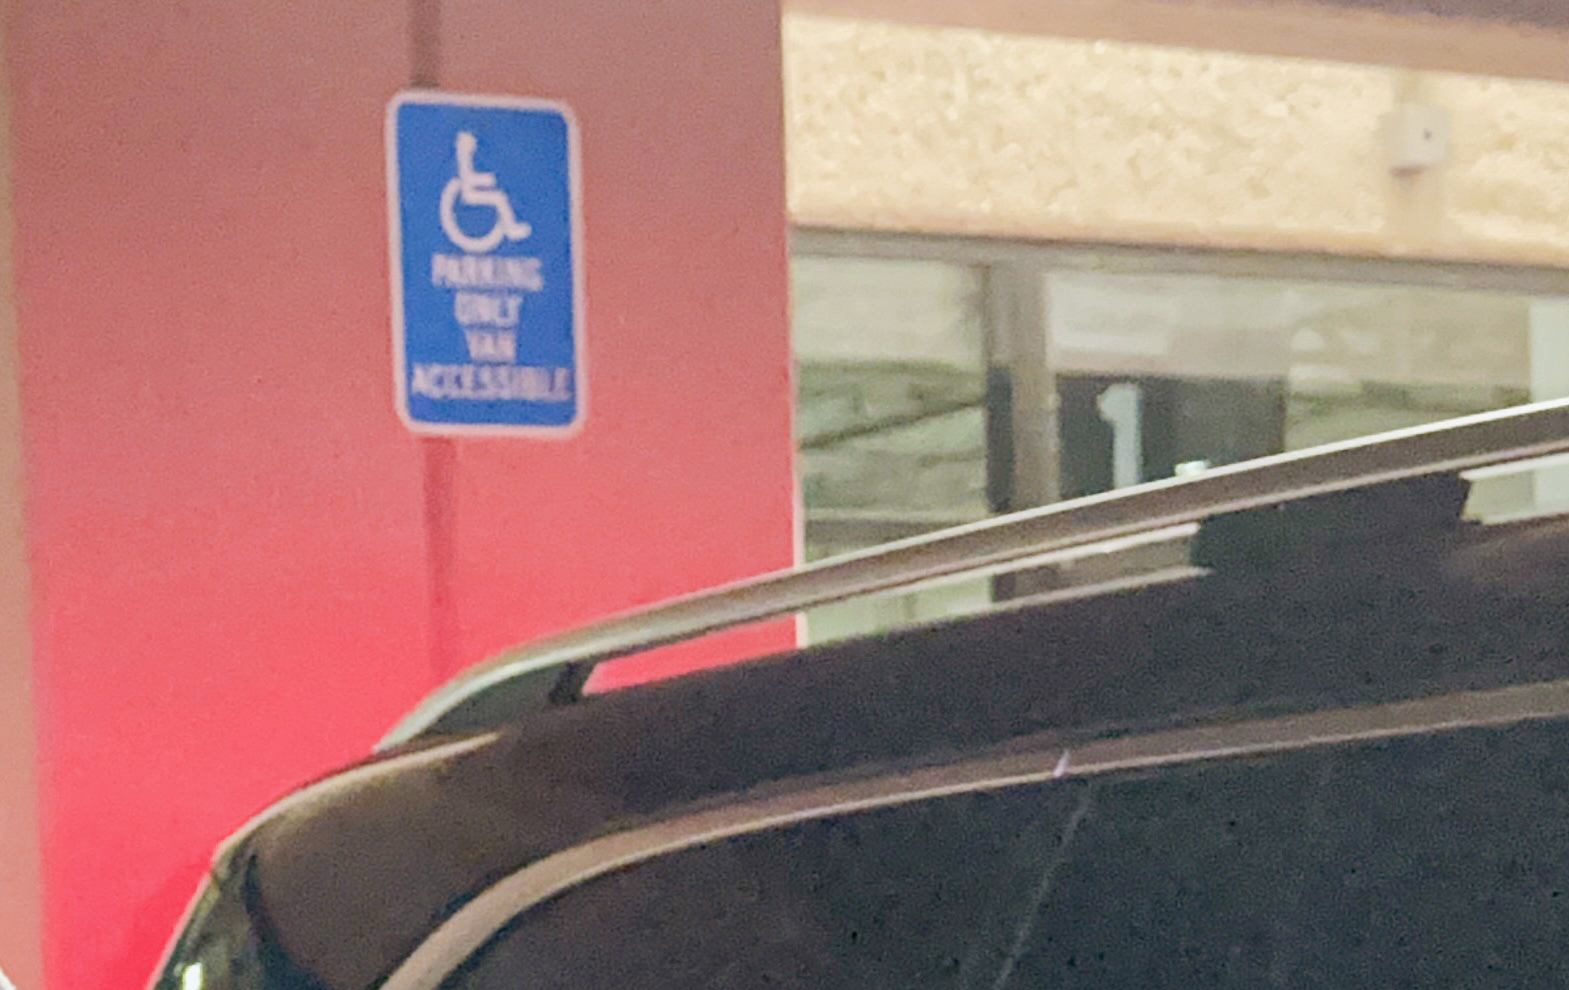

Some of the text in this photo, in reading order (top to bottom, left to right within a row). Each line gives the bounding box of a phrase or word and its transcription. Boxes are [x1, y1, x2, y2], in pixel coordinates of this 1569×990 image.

[431, 253, 545, 293] PARKING
[453, 292, 523, 327] ONLY
[464, 329, 518, 364] VAN
[411, 362, 573, 401] ACCESSIBLE
[1097, 382, 1142, 489] 1
